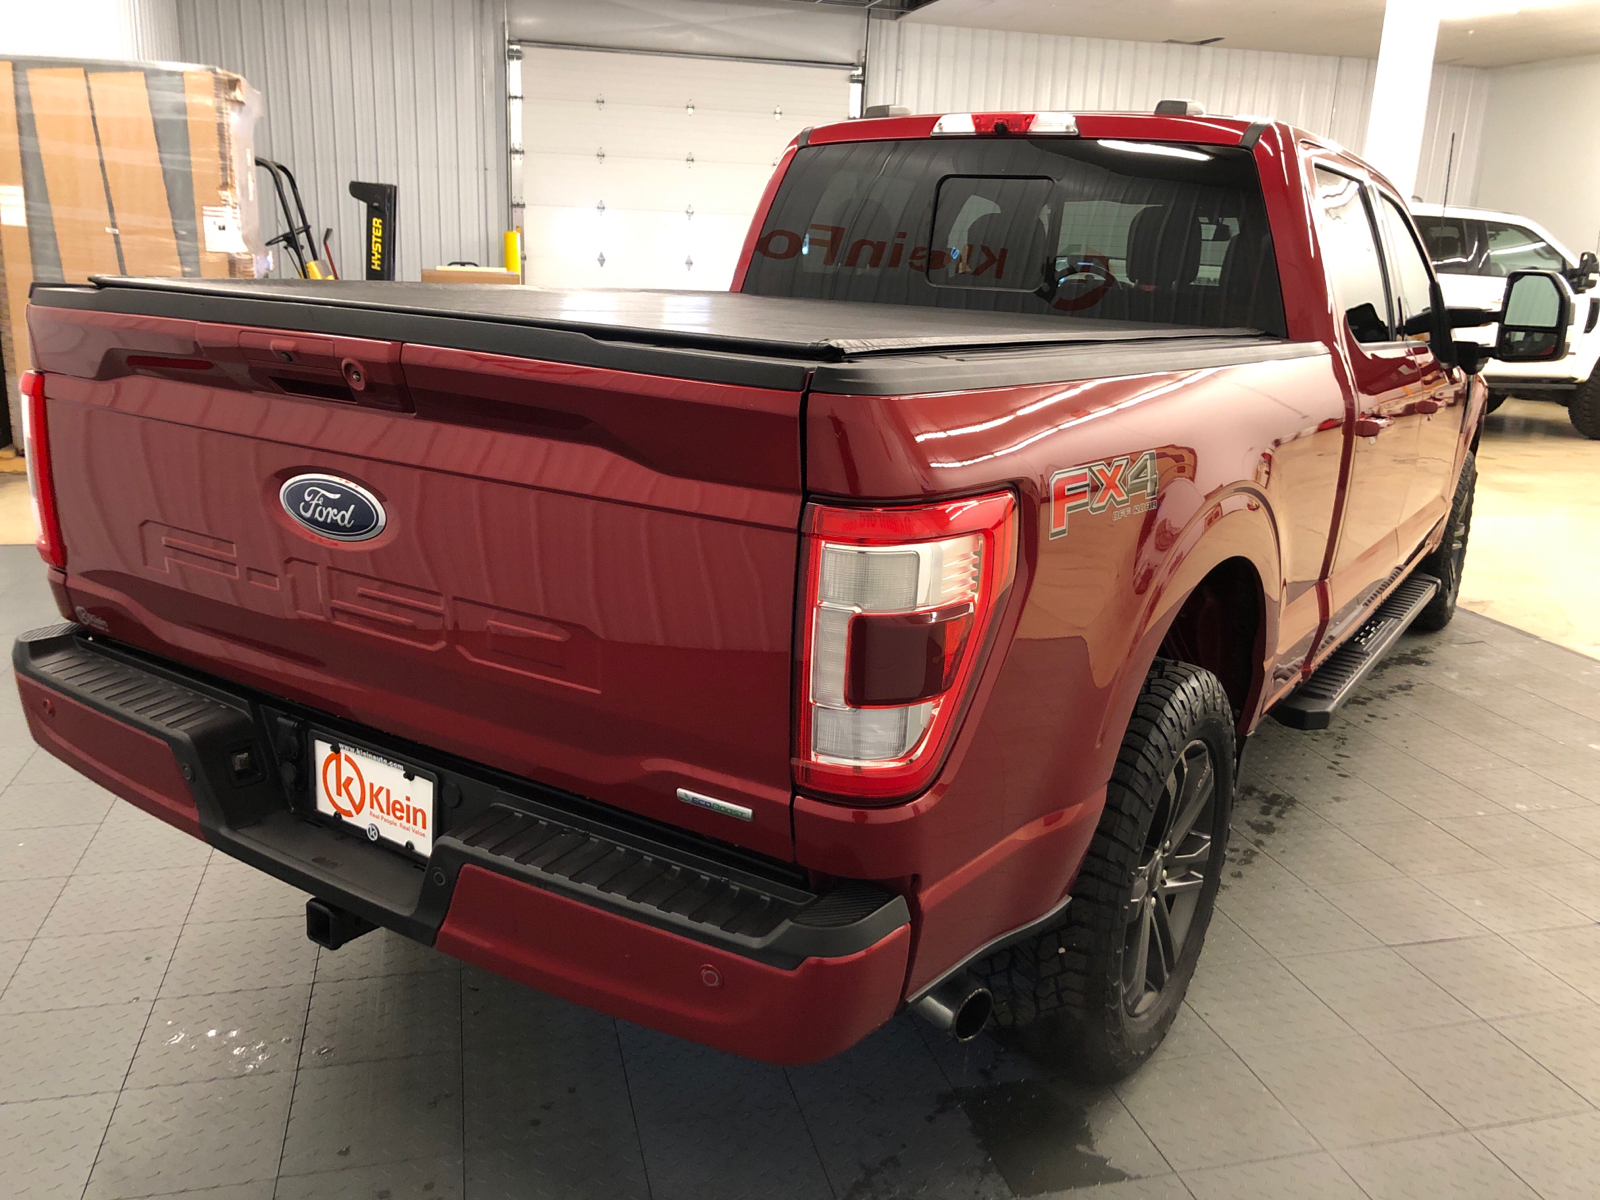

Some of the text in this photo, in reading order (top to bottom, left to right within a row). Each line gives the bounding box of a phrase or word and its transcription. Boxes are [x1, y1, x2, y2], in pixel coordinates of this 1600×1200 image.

[371, 217, 383, 271] HYSTER
[299, 486, 356, 528] Ford
[1049, 450, 1158, 540] FX4
[1112, 500, 1157, 521] OFF ROAD
[369, 781, 427, 830] Klein
[369, 810, 380, 820] Real
[399, 822, 411, 832] Real
